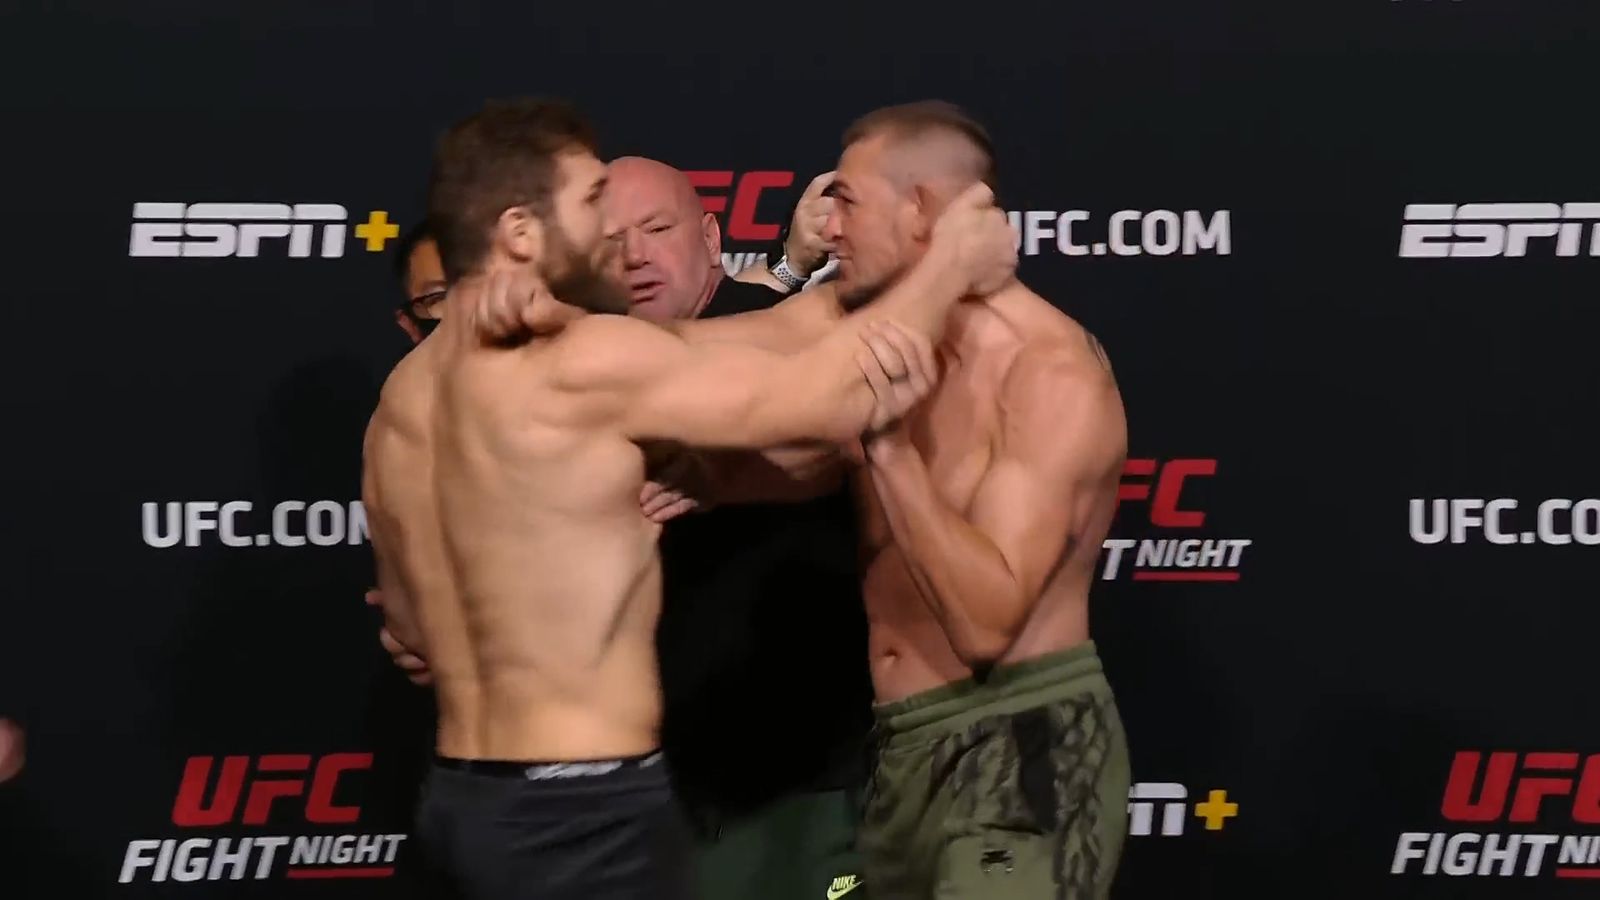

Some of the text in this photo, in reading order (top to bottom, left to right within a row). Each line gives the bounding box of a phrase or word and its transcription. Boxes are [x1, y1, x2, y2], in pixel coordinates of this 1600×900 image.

[1135, 539, 1253, 567] NIGHT
[171, 753, 374, 827] UFC
[118, 834, 408, 883] FIGHT NIGHT
[1390, 832, 1560, 877] FIGHT
[832, 875, 856, 890] NIKE
